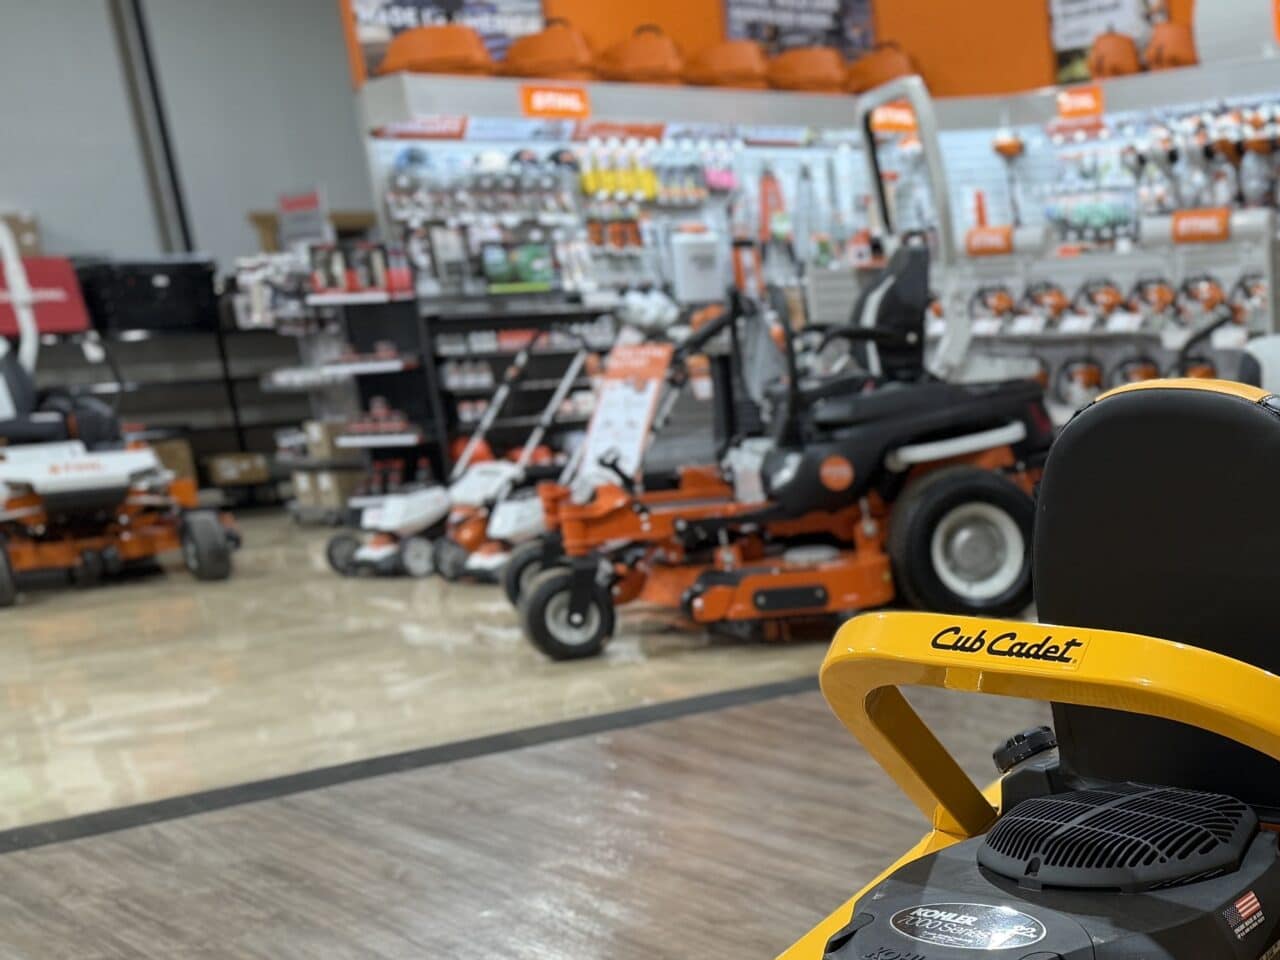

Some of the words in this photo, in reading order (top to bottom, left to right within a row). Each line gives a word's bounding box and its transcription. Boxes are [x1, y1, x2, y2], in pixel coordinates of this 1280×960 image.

[931, 626, 988, 653] Cub
[986, 632, 1083, 663] Cadet
[897, 915, 939, 930] 7000
[909, 907, 978, 927] KOHLER
